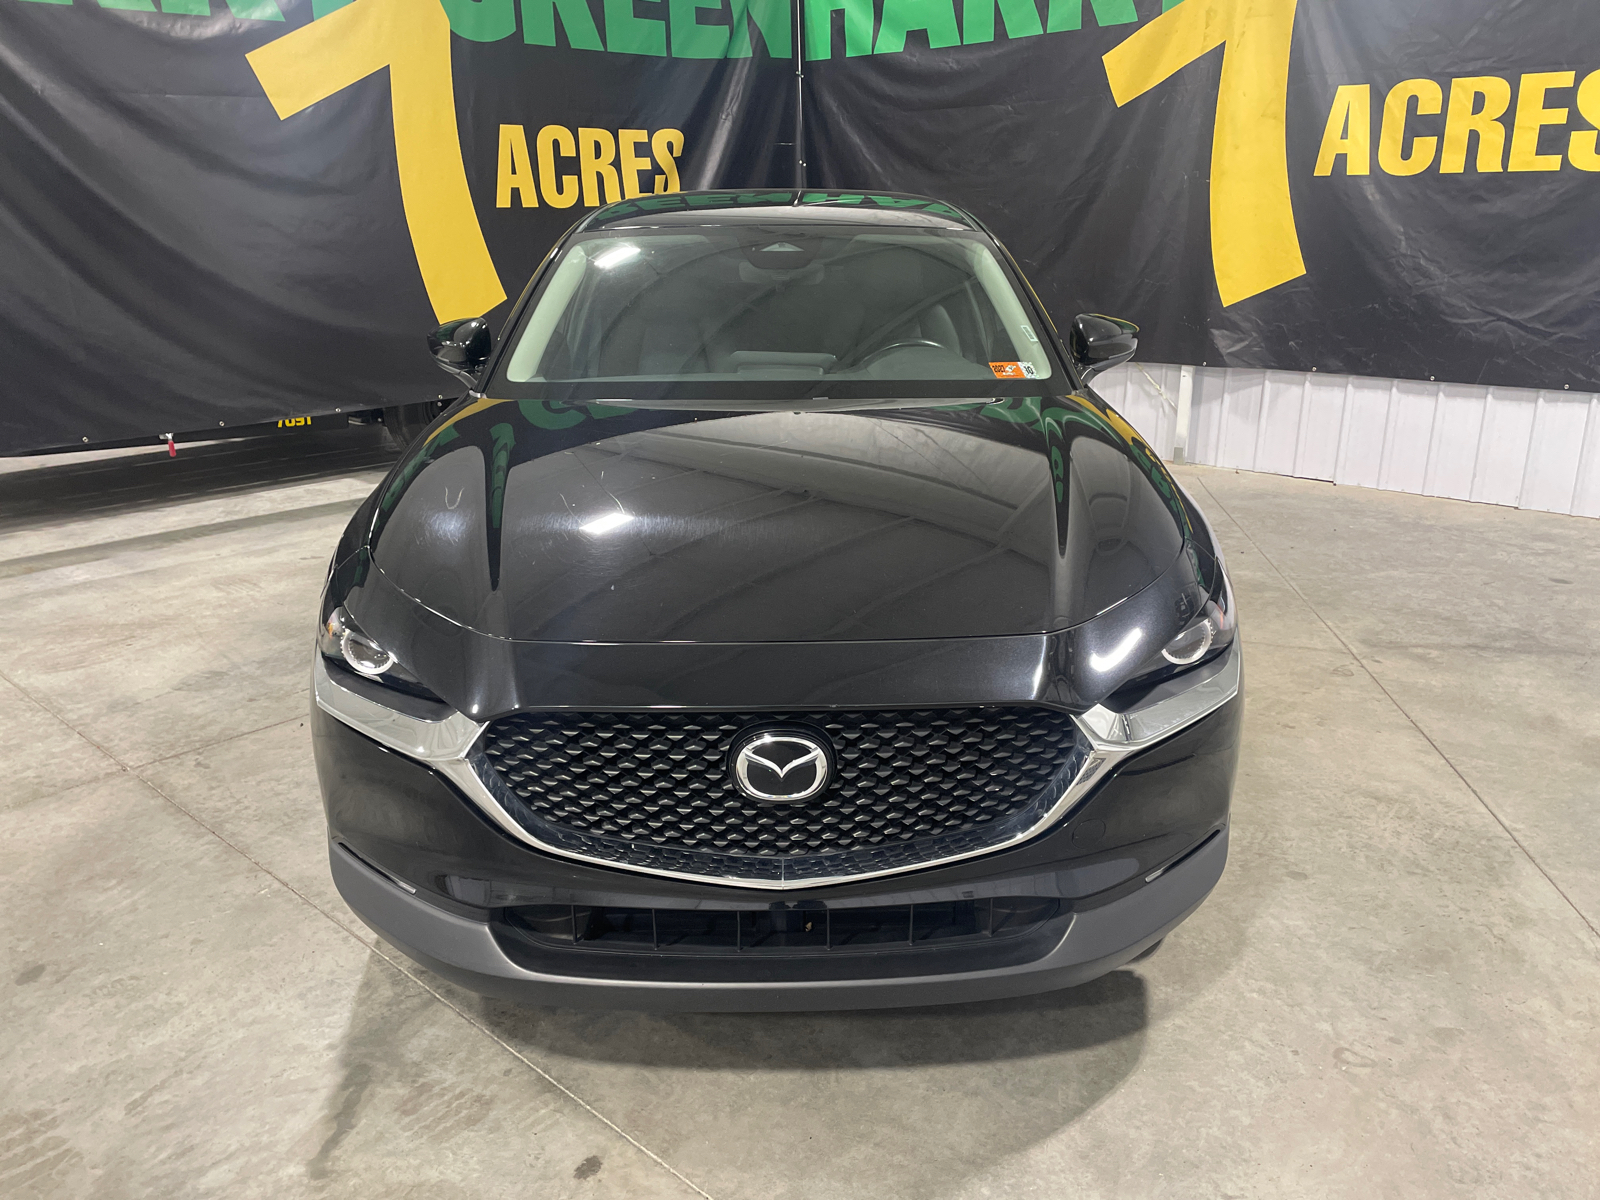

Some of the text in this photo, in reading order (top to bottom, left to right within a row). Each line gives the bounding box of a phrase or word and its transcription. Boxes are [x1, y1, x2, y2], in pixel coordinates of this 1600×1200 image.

[245, 0, 684, 325] 7 ACRES
[1102, 0, 1306, 307] 7
